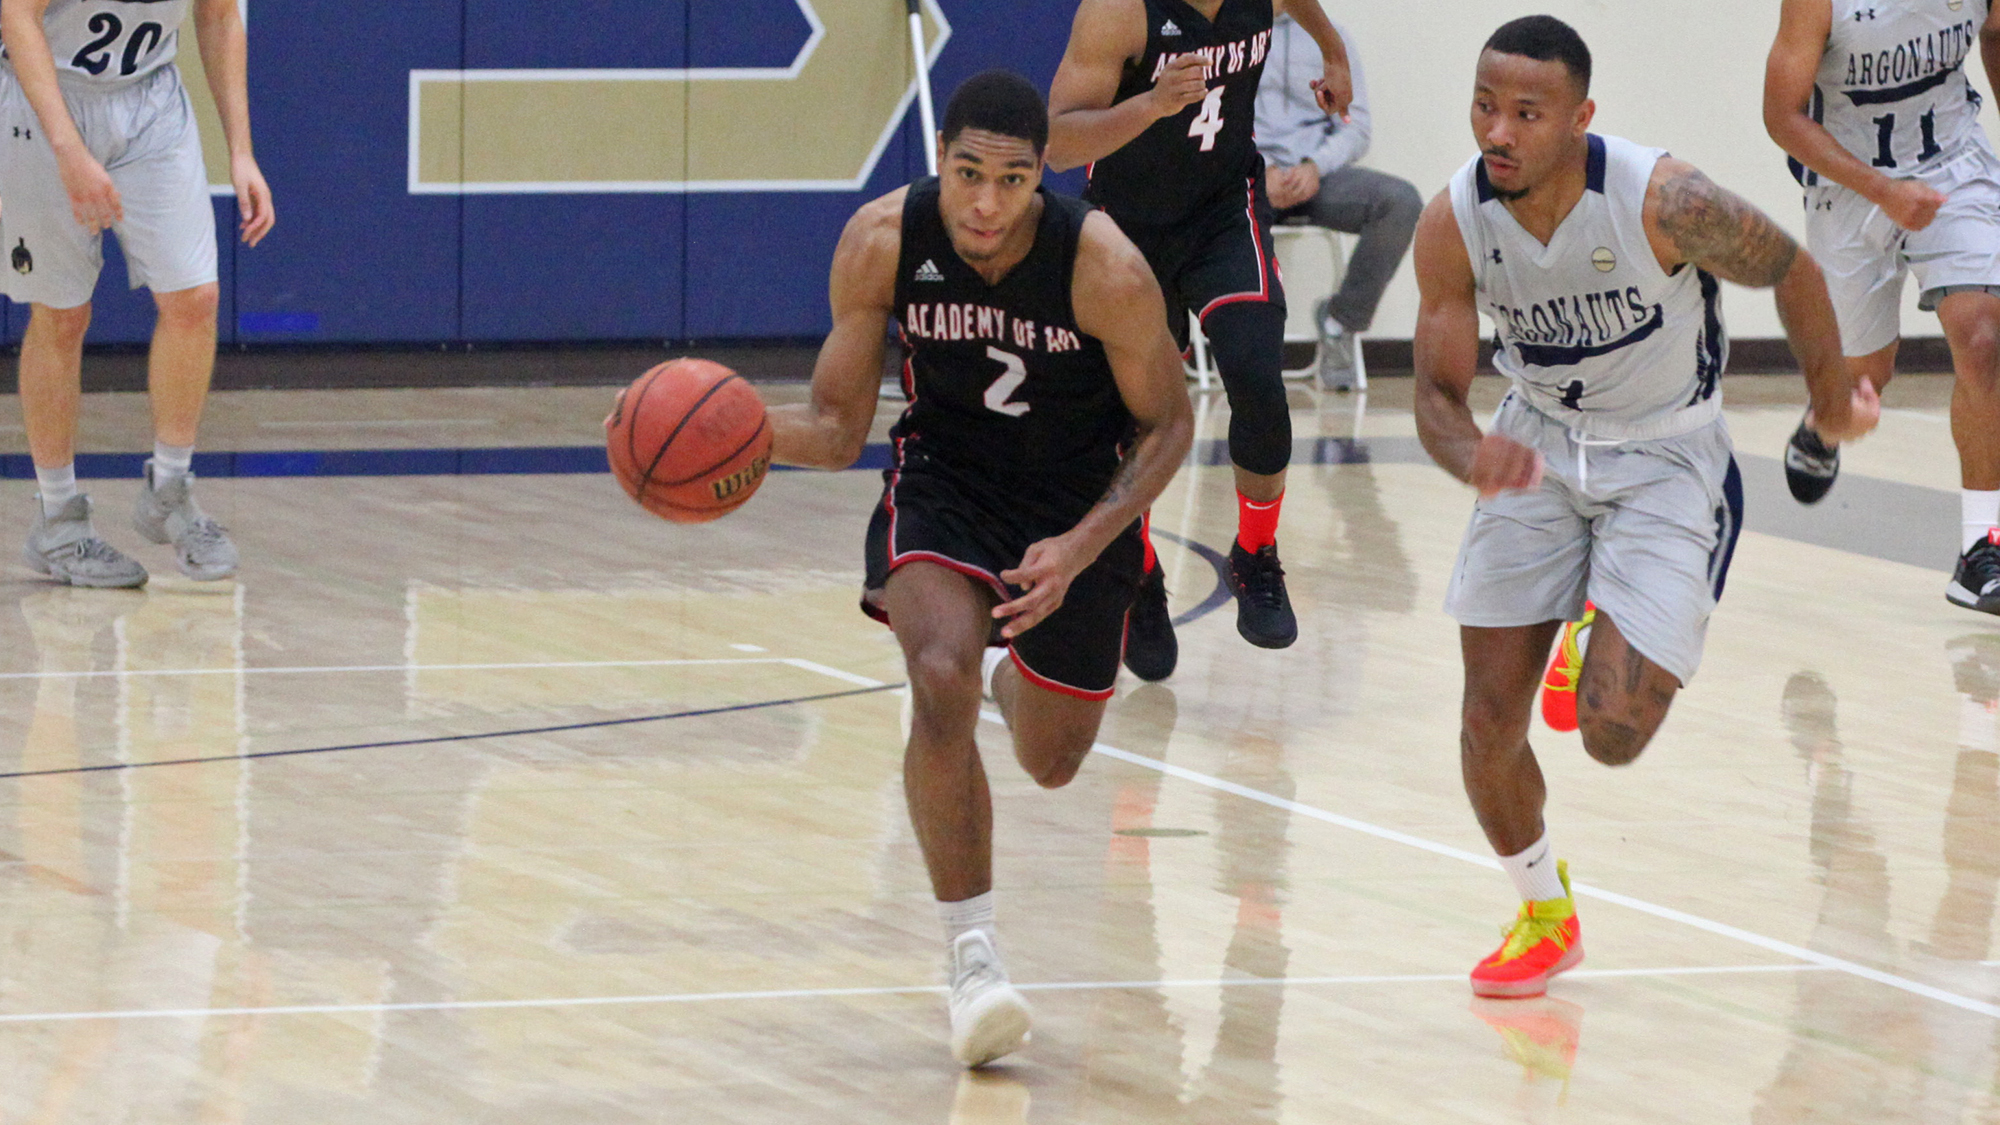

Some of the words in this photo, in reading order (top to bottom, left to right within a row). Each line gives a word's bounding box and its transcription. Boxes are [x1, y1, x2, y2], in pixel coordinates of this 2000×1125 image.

[71, 12, 162, 75] 20
[1226, 40, 1247, 74] OF
[1249, 29, 1271, 68] AR
[1844, 19, 1973, 86] ARGONAUTS
[1187, 85, 1225, 152] 4
[1872, 104, 1941, 168] 11
[907, 302, 1005, 341] ACADEMY
[1012, 317, 1036, 349] OF
[983, 345, 1030, 417] 2
